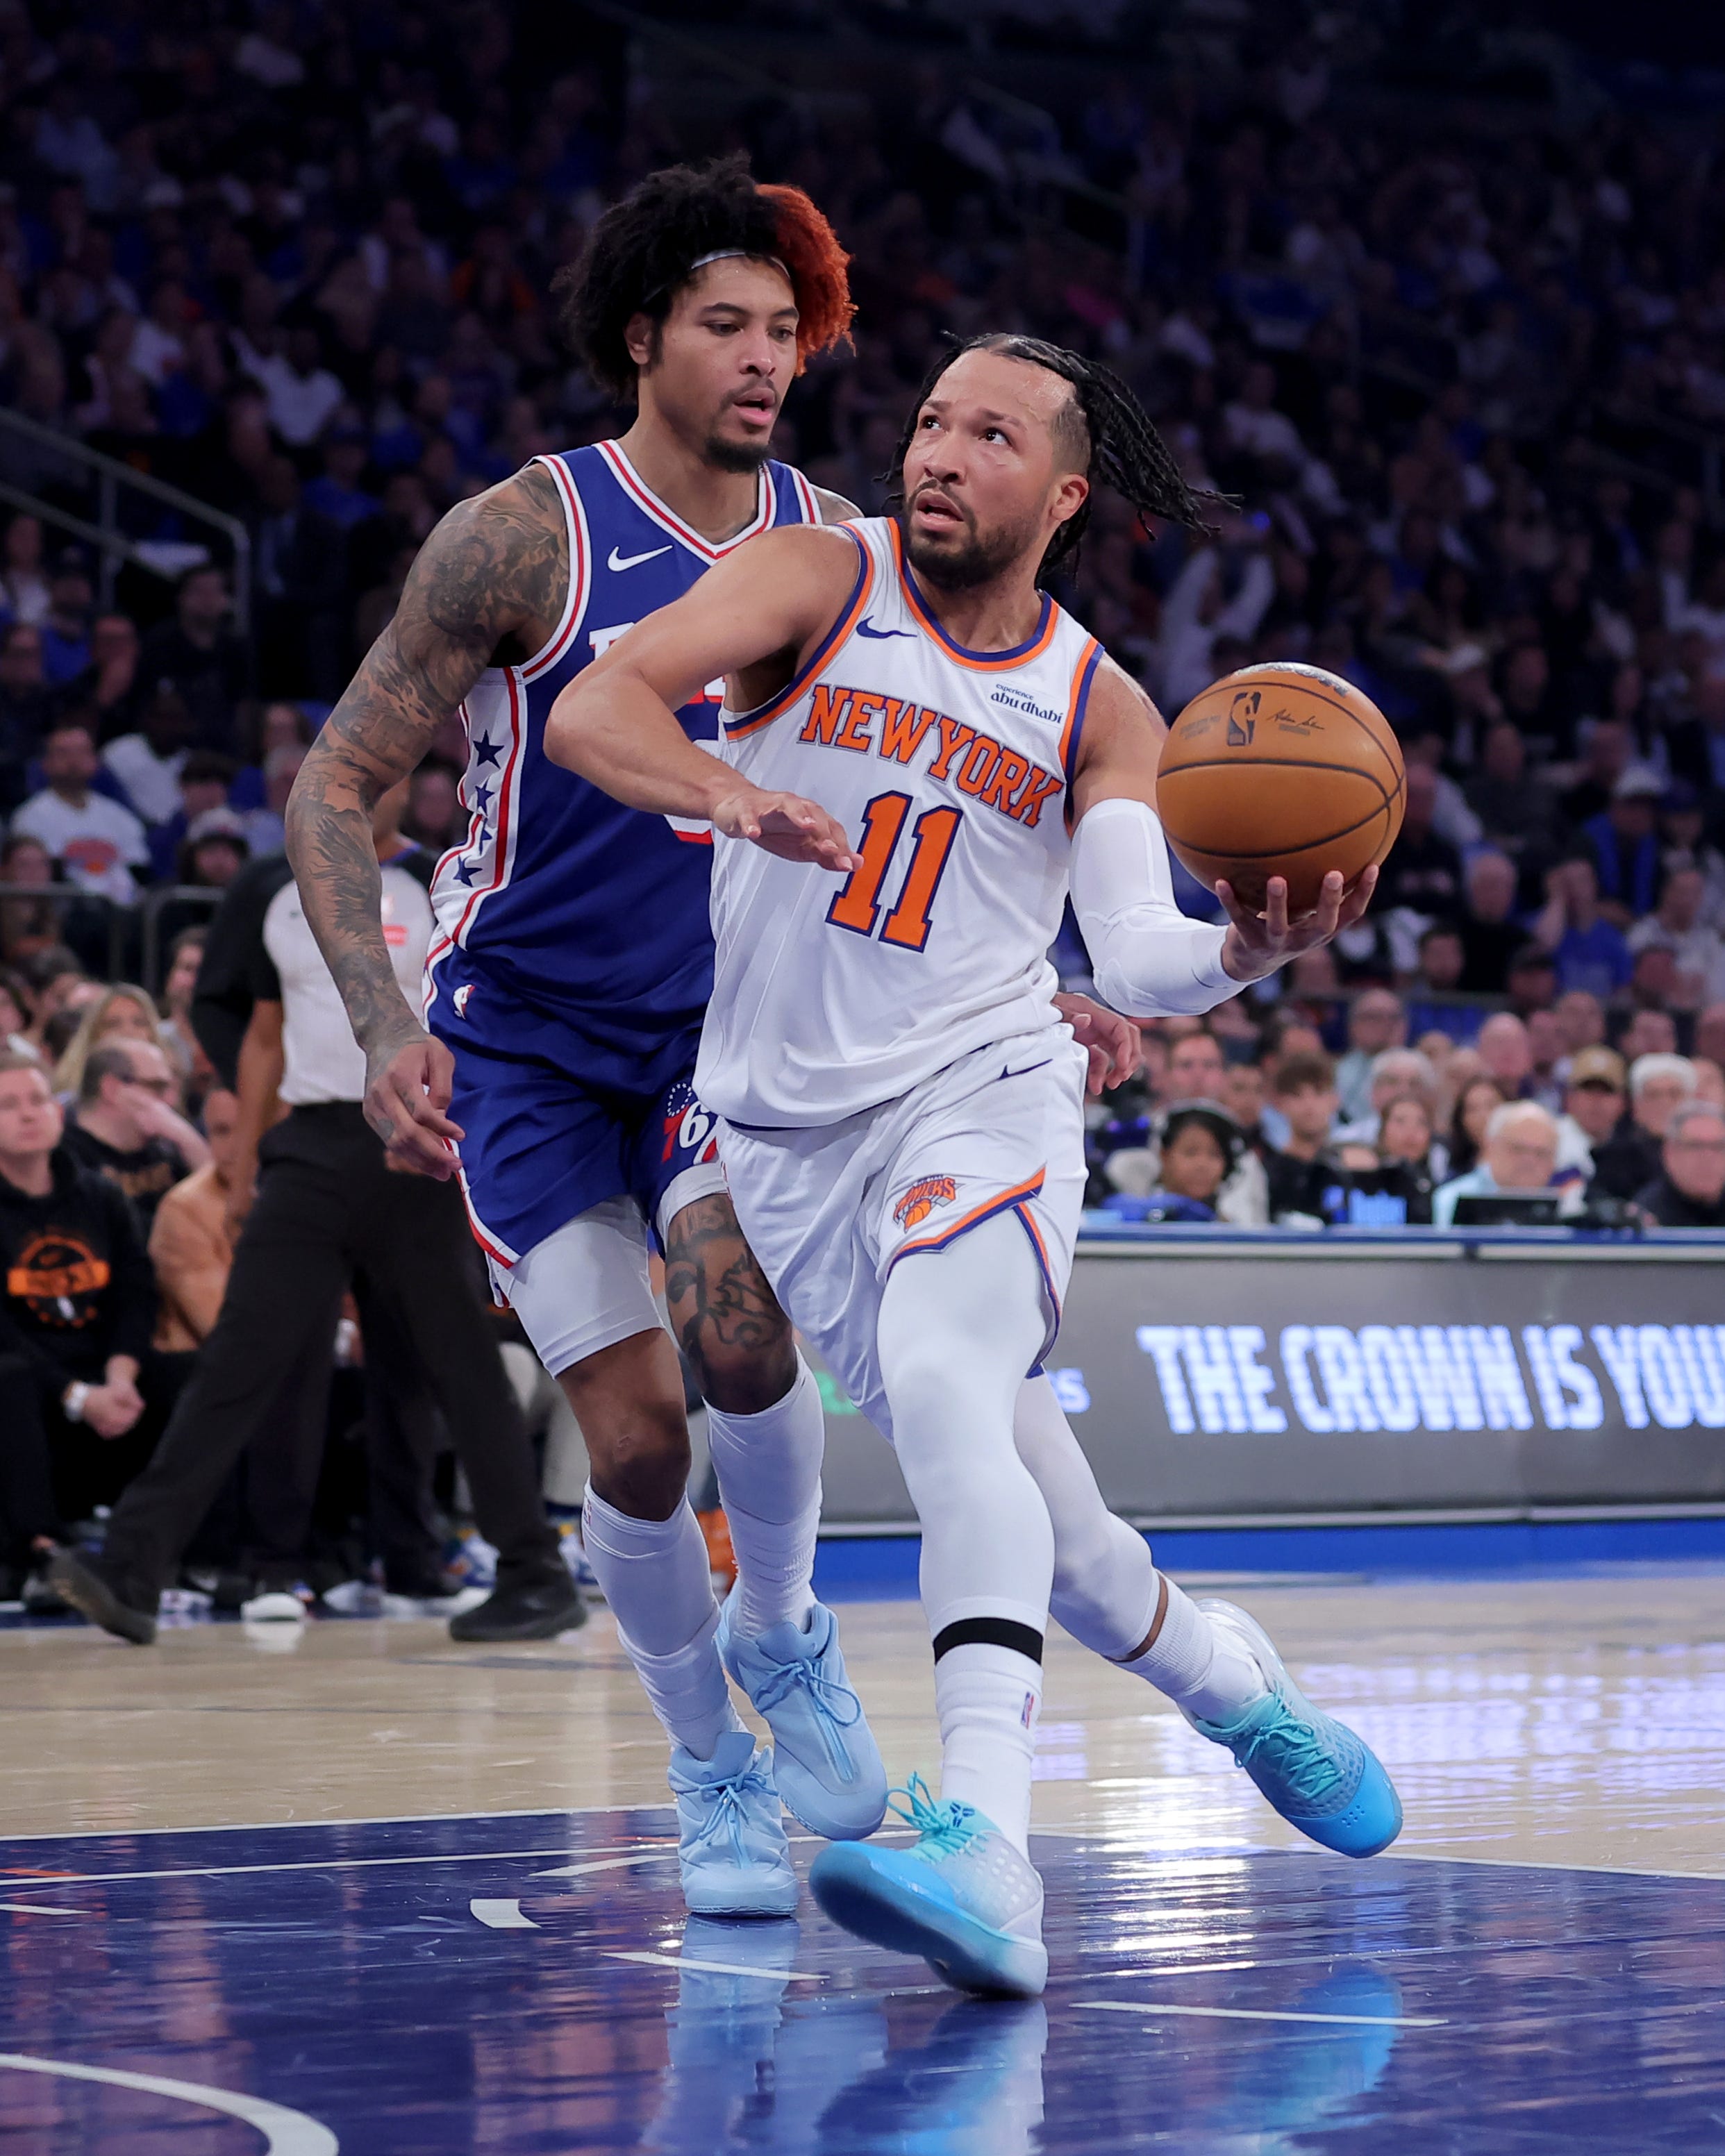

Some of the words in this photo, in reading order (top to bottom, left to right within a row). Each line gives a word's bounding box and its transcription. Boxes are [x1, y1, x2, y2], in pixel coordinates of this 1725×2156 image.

[990, 692, 1019, 709] abu
[1020, 701, 1064, 724] dhabi
[996, 683, 1034, 701] experience
[798, 684, 938, 767] NEW
[926, 714, 1065, 829] YORK
[824, 789, 964, 953] 11
[1137, 1325, 1288, 1434] THE
[1279, 1325, 1534, 1432] CROWN
[1522, 1324, 1605, 1431] IS
